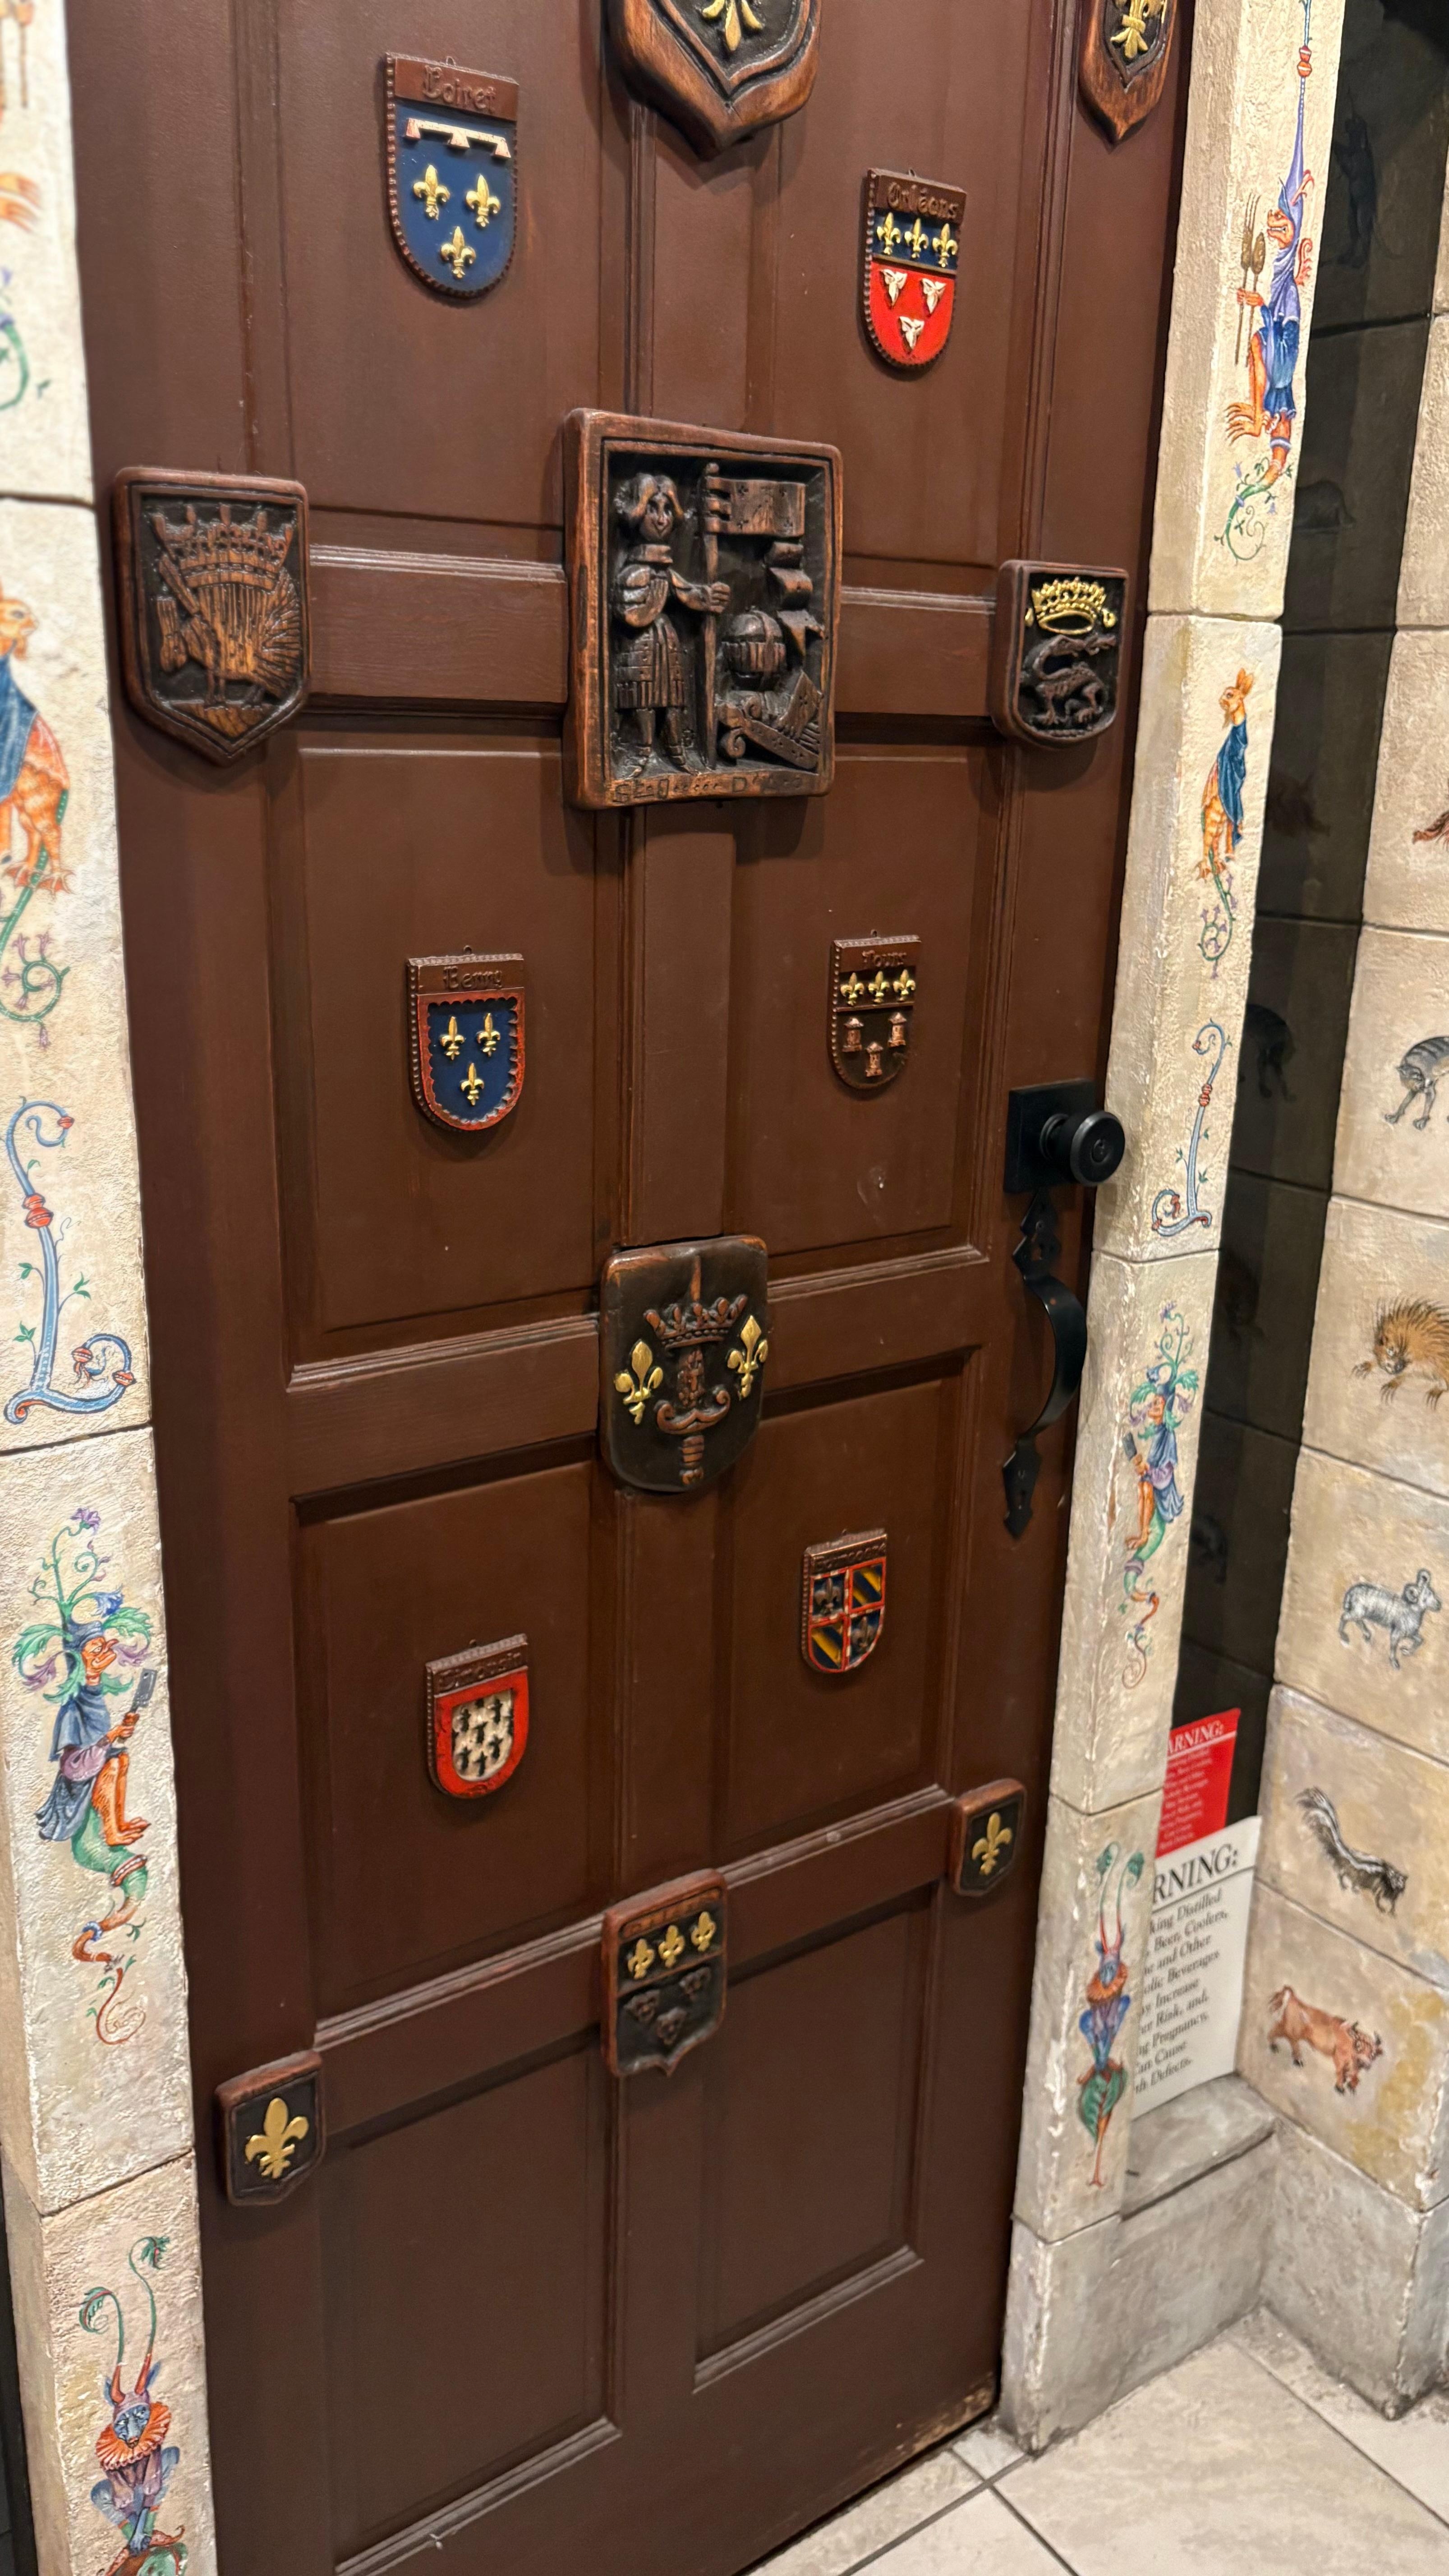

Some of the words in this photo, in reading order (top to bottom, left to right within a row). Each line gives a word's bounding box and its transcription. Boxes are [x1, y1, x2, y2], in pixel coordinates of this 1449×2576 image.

[1177, 1887, 1222, 1921] Distilled
[1179, 1935, 1211, 1957] Other
[1167, 1950, 1220, 1983] Beverages
[1156, 1978, 1200, 2008] Increase
[1155, 2041, 1187, 2065] Cause
